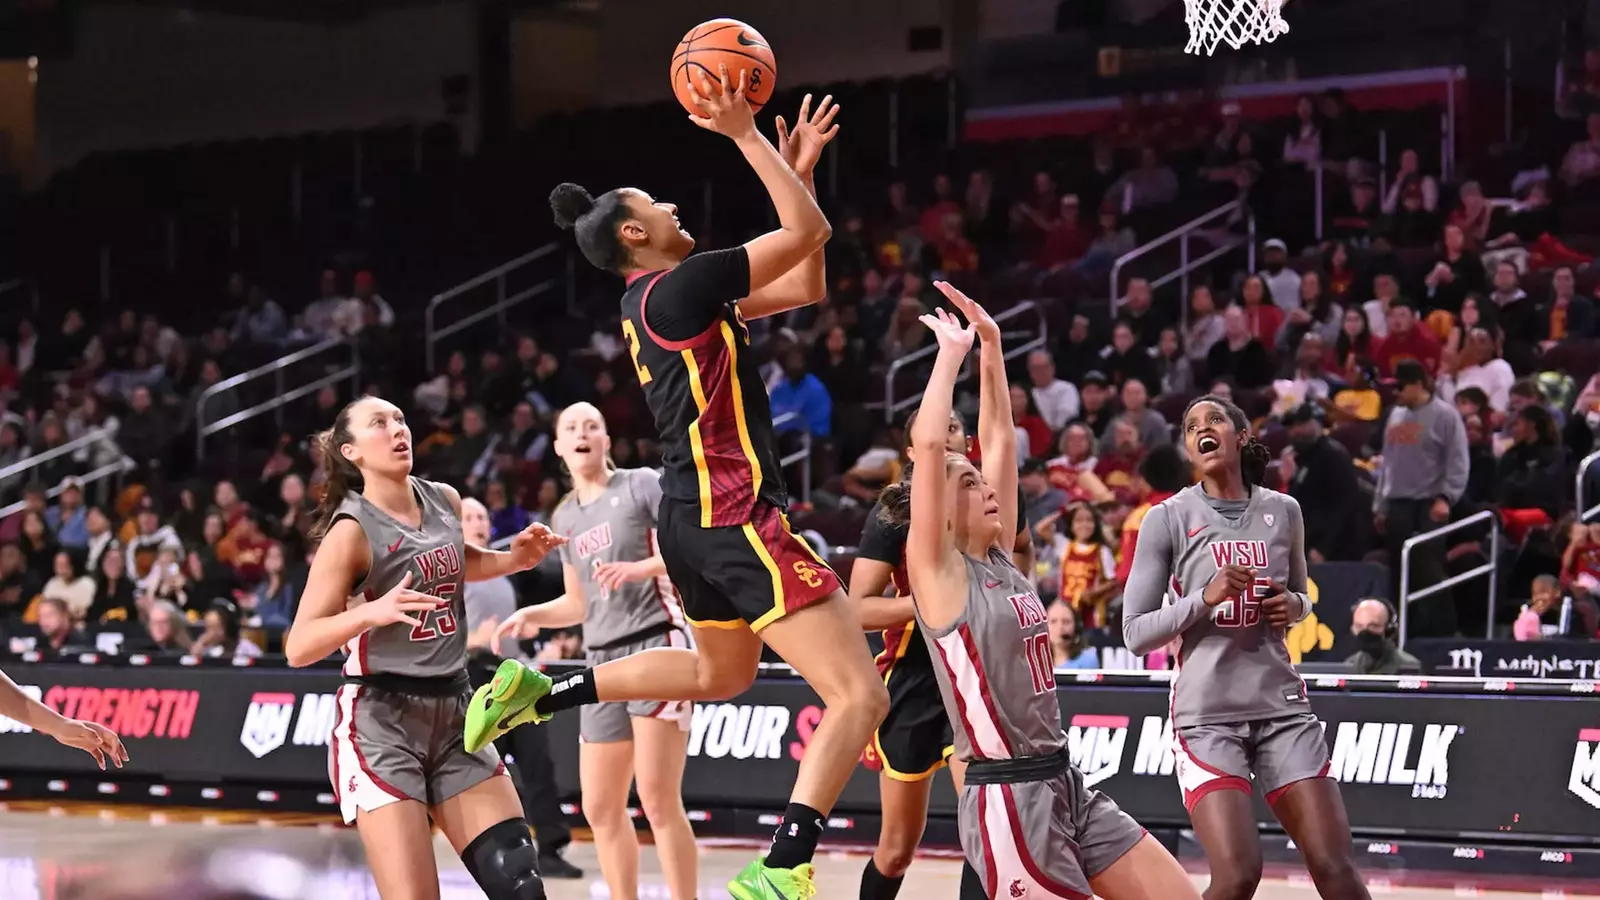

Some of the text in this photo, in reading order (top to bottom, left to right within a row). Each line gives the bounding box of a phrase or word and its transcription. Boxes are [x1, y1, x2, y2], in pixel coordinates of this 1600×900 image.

[575, 521, 613, 560] WSU
[1208, 540, 1269, 570] WSU
[413, 542, 460, 584] WSU
[792, 560, 823, 588] SC
[1006, 589, 1049, 630] WSU
[1023, 631, 1057, 696] 10
[687, 703, 790, 760] YOUR
[1330, 721, 1459, 785] MILK
